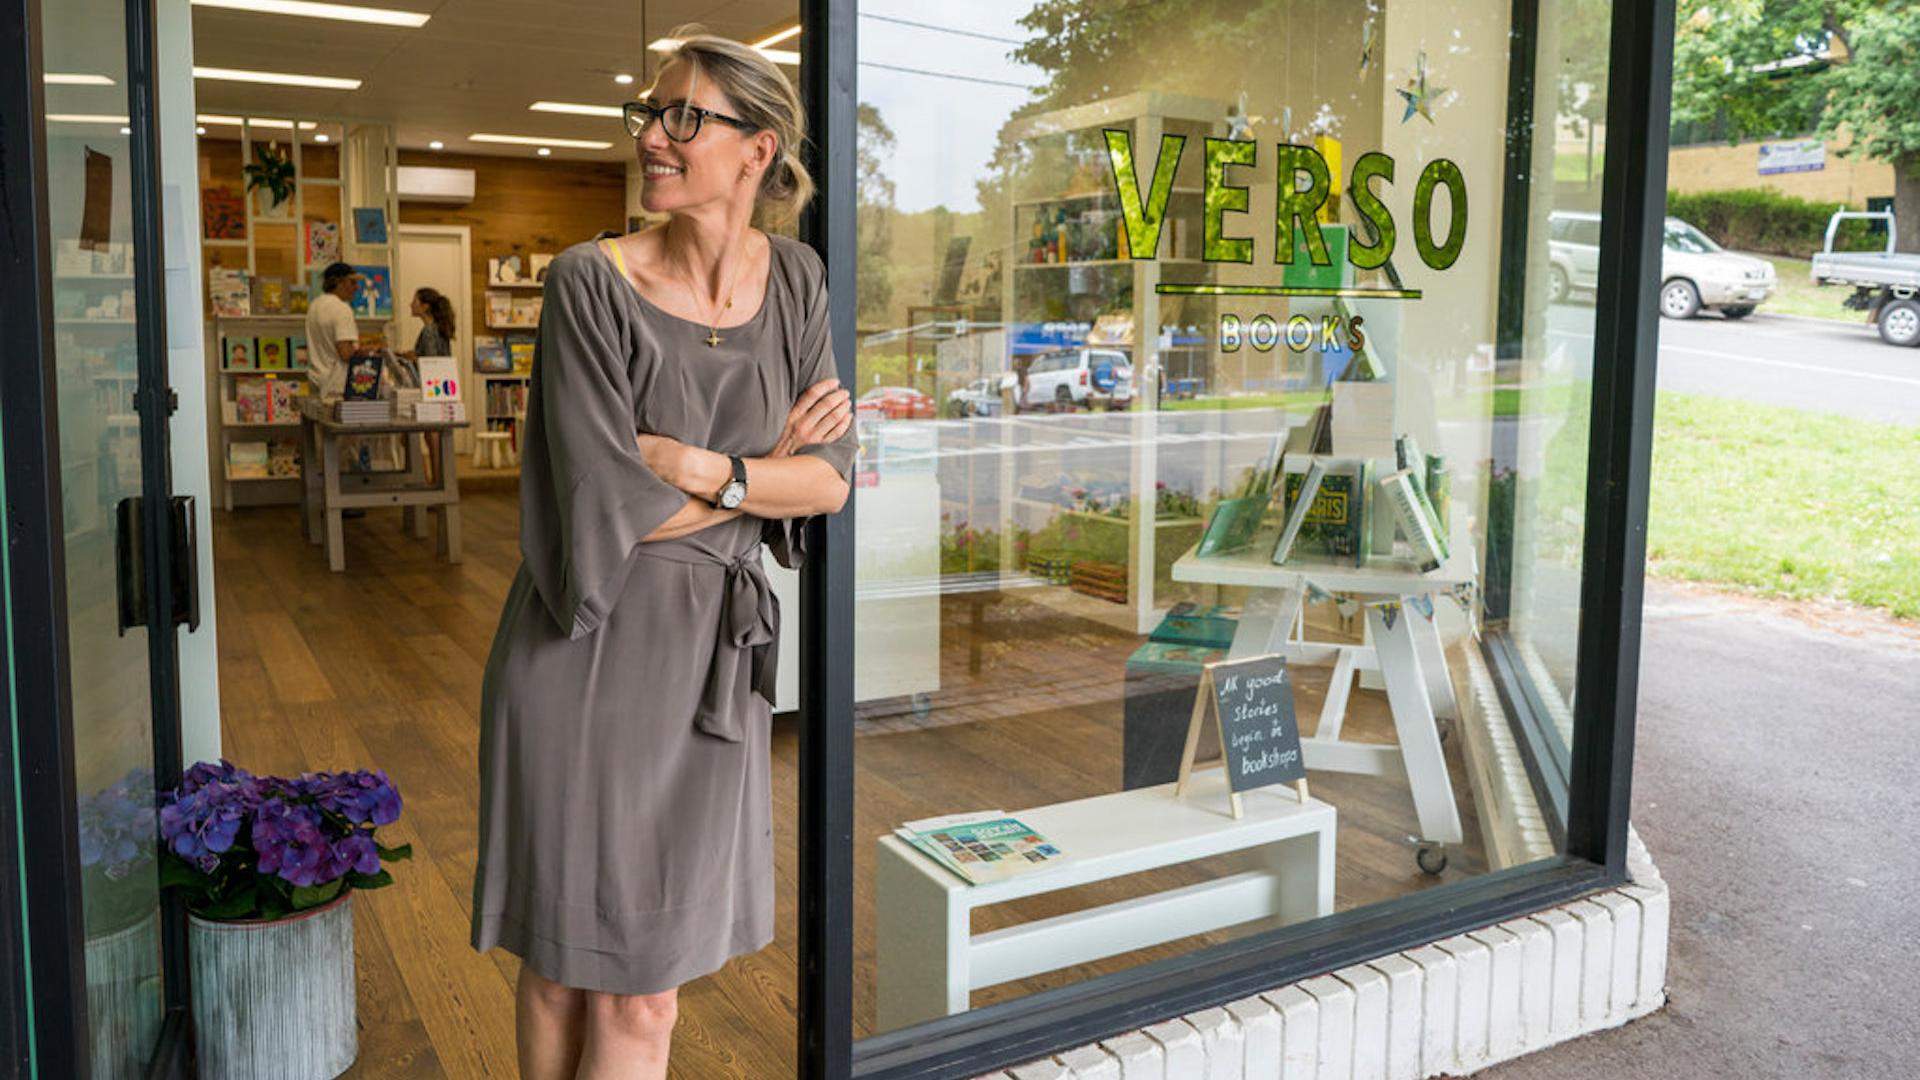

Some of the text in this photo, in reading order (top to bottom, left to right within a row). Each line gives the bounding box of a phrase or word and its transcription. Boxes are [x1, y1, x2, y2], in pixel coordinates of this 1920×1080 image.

[1103, 129, 1468, 270] VERSO
[1220, 314, 1364, 353] BOOKS
[1245, 668, 1284, 701] good
[1232, 718, 1282, 752] begin in
